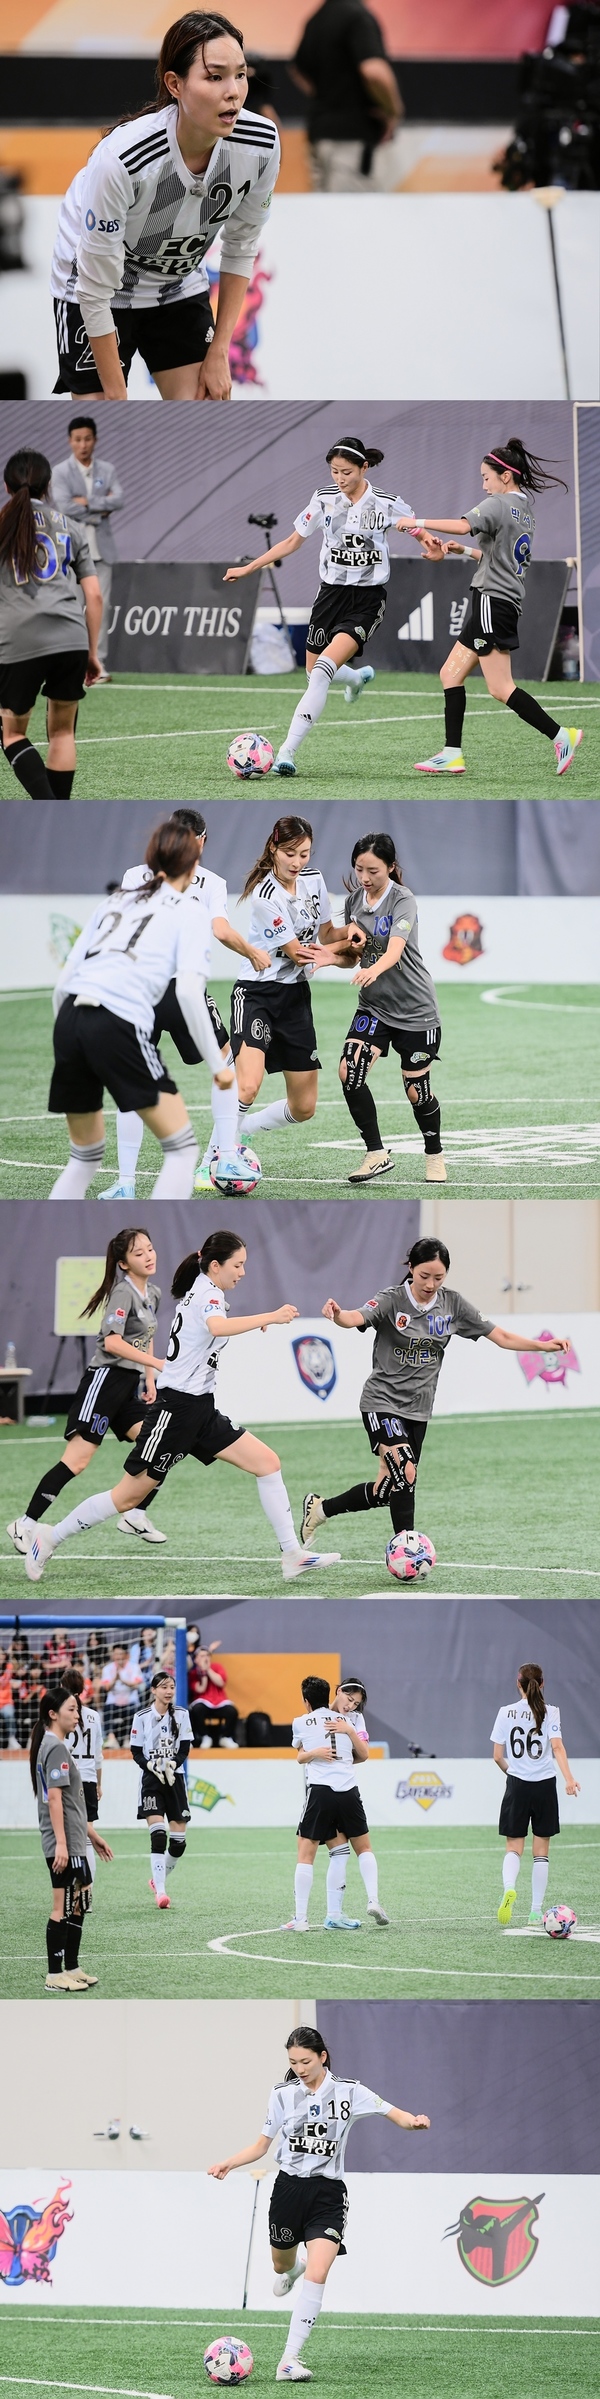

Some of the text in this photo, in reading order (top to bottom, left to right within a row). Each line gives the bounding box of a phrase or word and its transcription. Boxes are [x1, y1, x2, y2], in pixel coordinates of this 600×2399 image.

[98, 219, 120, 232] SBS
[157, 234, 207, 257] FC
[361, 509, 385, 531] 100
[341, 533, 365, 549] FC
[331, 548, 383, 567] 구척장신
[513, 532, 532, 577] 9
[124, 605, 178, 636] GOT
[183, 606, 242, 638] THIS
[84, 911, 155, 962] 21
[273, 925, 287, 936] SBS
[409, 1337, 434, 1350] FC
[90, 1413, 109, 1436] 10
[509, 1726, 544, 1760] 66
[327, 2099, 351, 2121] 18
[303, 2122, 328, 2138] FC
[270, 2223, 295, 2242] 18
